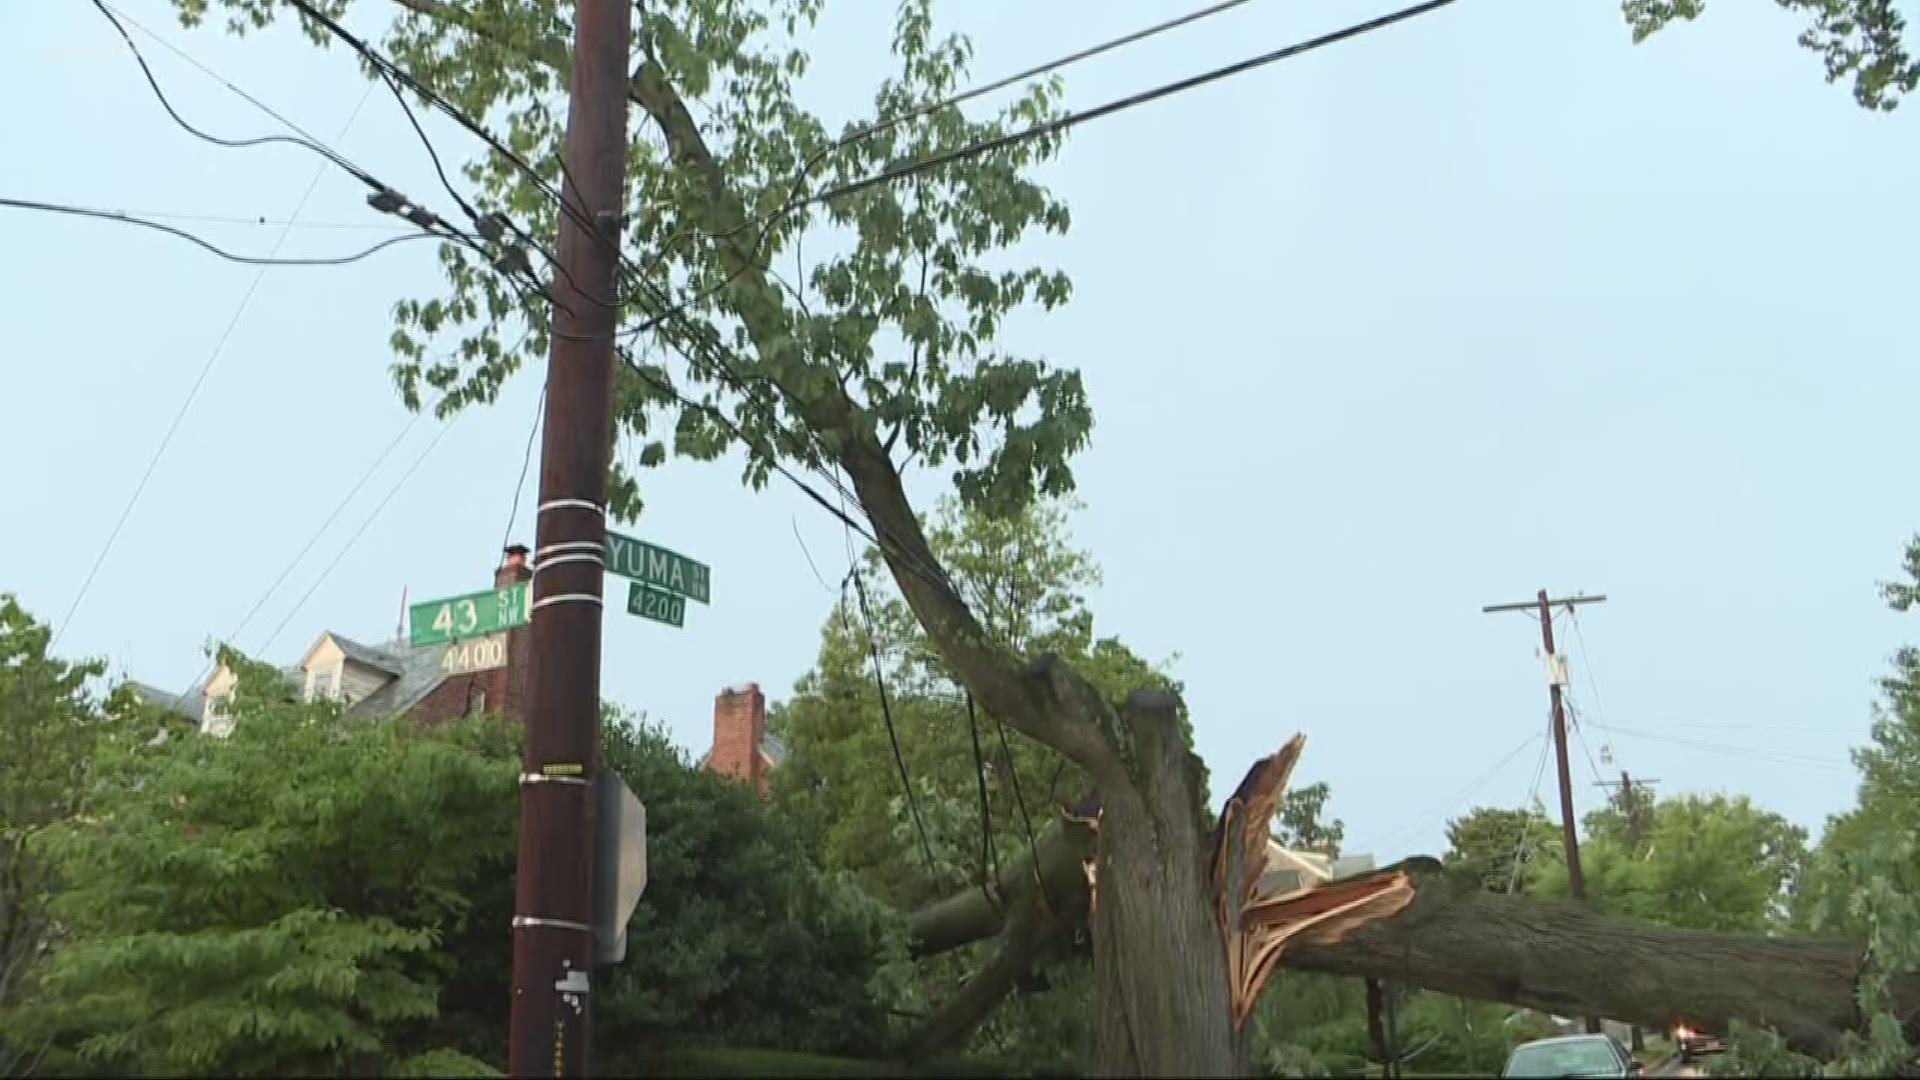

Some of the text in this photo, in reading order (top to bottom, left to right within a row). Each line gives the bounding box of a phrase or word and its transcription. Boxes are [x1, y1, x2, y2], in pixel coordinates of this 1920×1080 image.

[607, 536, 684, 591] YUMA
[499, 587, 519, 608] ST
[632, 590, 681, 623] 4200
[432, 599, 477, 637] 43
[498, 607, 519, 627] NW
[441, 640, 502, 673] 4400
